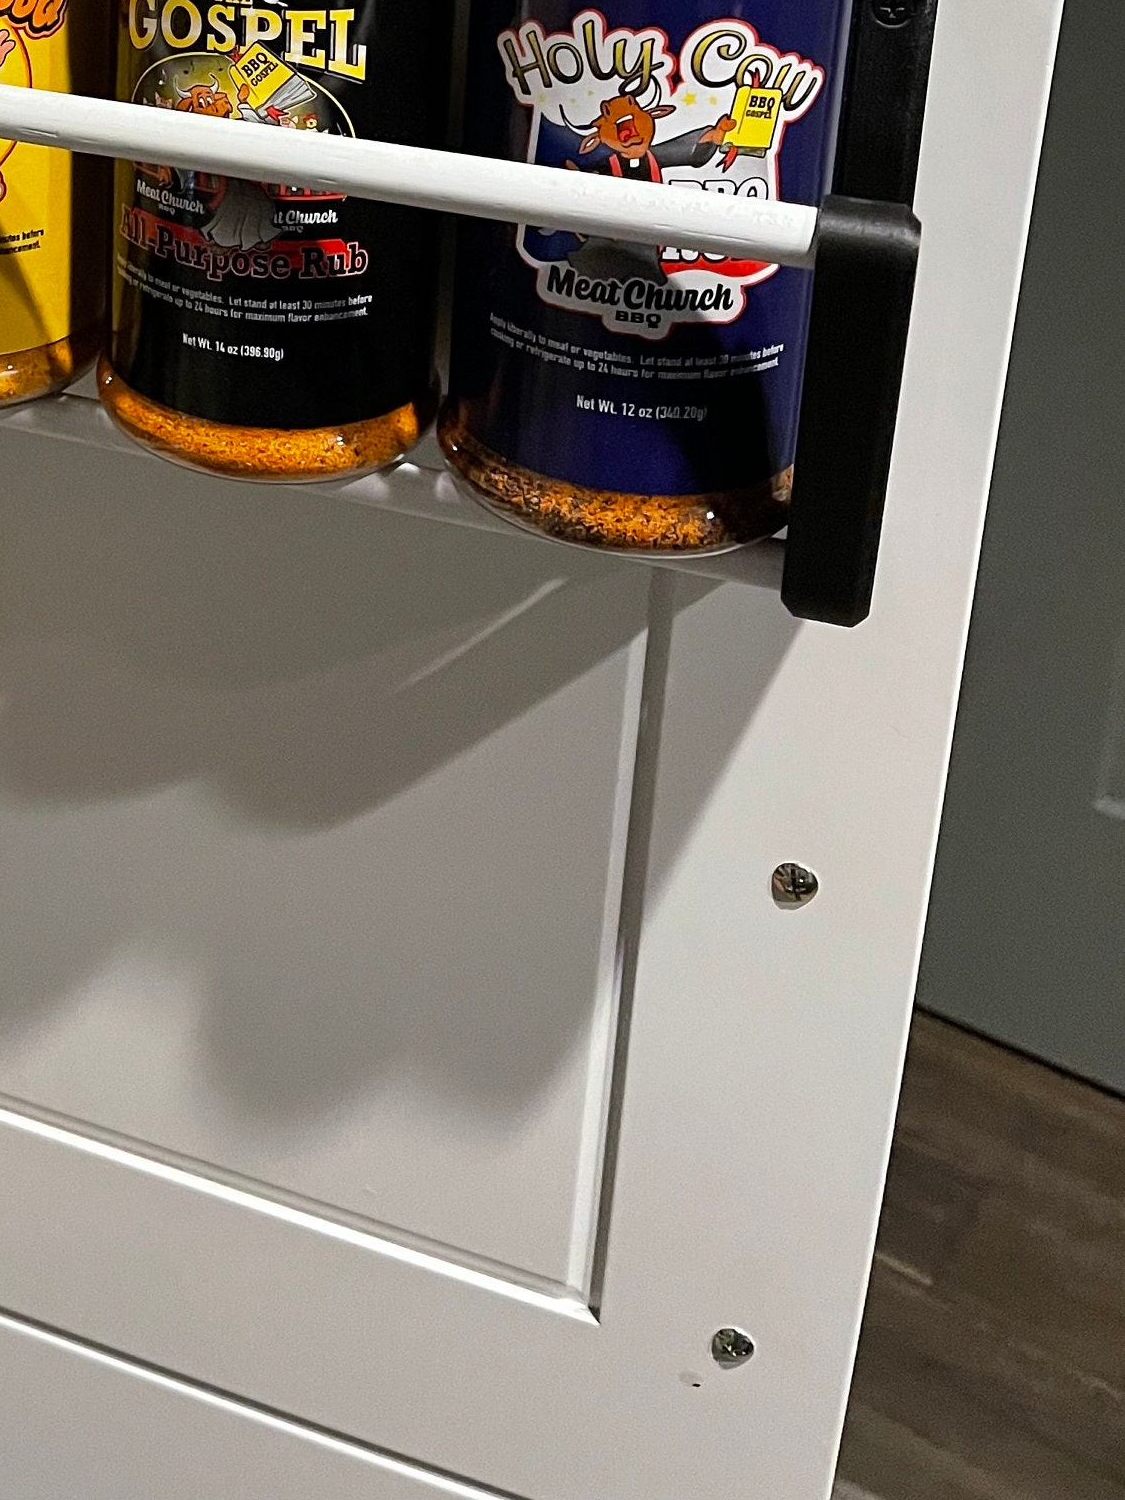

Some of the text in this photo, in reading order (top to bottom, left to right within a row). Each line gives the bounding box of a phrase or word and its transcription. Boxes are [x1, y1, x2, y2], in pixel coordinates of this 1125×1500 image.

[241, 50, 271, 78] BBQ
[250, 60, 279, 86] GOSPEL
[504, 20, 817, 111] Holy Cow
[749, 95, 775, 111] BBQ
[136, 179, 205, 215] Meat Church
[285, 210, 338, 225] Church
[299, 241, 368, 279] Rub
[547, 266, 734, 311] Meat Church
[194, 301, 203, 312] 24
[205, 304, 228, 317] hours
[230, 309, 243, 319] for
[288, 313, 312, 322] flavor
[229, 296, 242, 306] Let
[244, 299, 267, 309] stand
[269, 300, 277, 309] at
[279, 300, 300, 310] least
[302, 300, 312, 310] 30
[348, 295, 373, 306] before
[615, 311, 661, 328] BBQ
[182, 333, 196, 347] Net
[215, 341, 225, 352] 14
[227, 346, 238, 355] oz
[240, 345, 284, 361] (396.90g)
[571, 346, 581, 354] or
[640, 355, 654, 365] Let
[574, 359, 584, 370] up
[587, 361, 595, 371] to
[598, 362, 608, 373] 24
[610, 364, 638, 378] hours
[576, 394, 595, 410] Net
[621, 403, 635, 417] 12
[638, 407, 653, 418] oz
